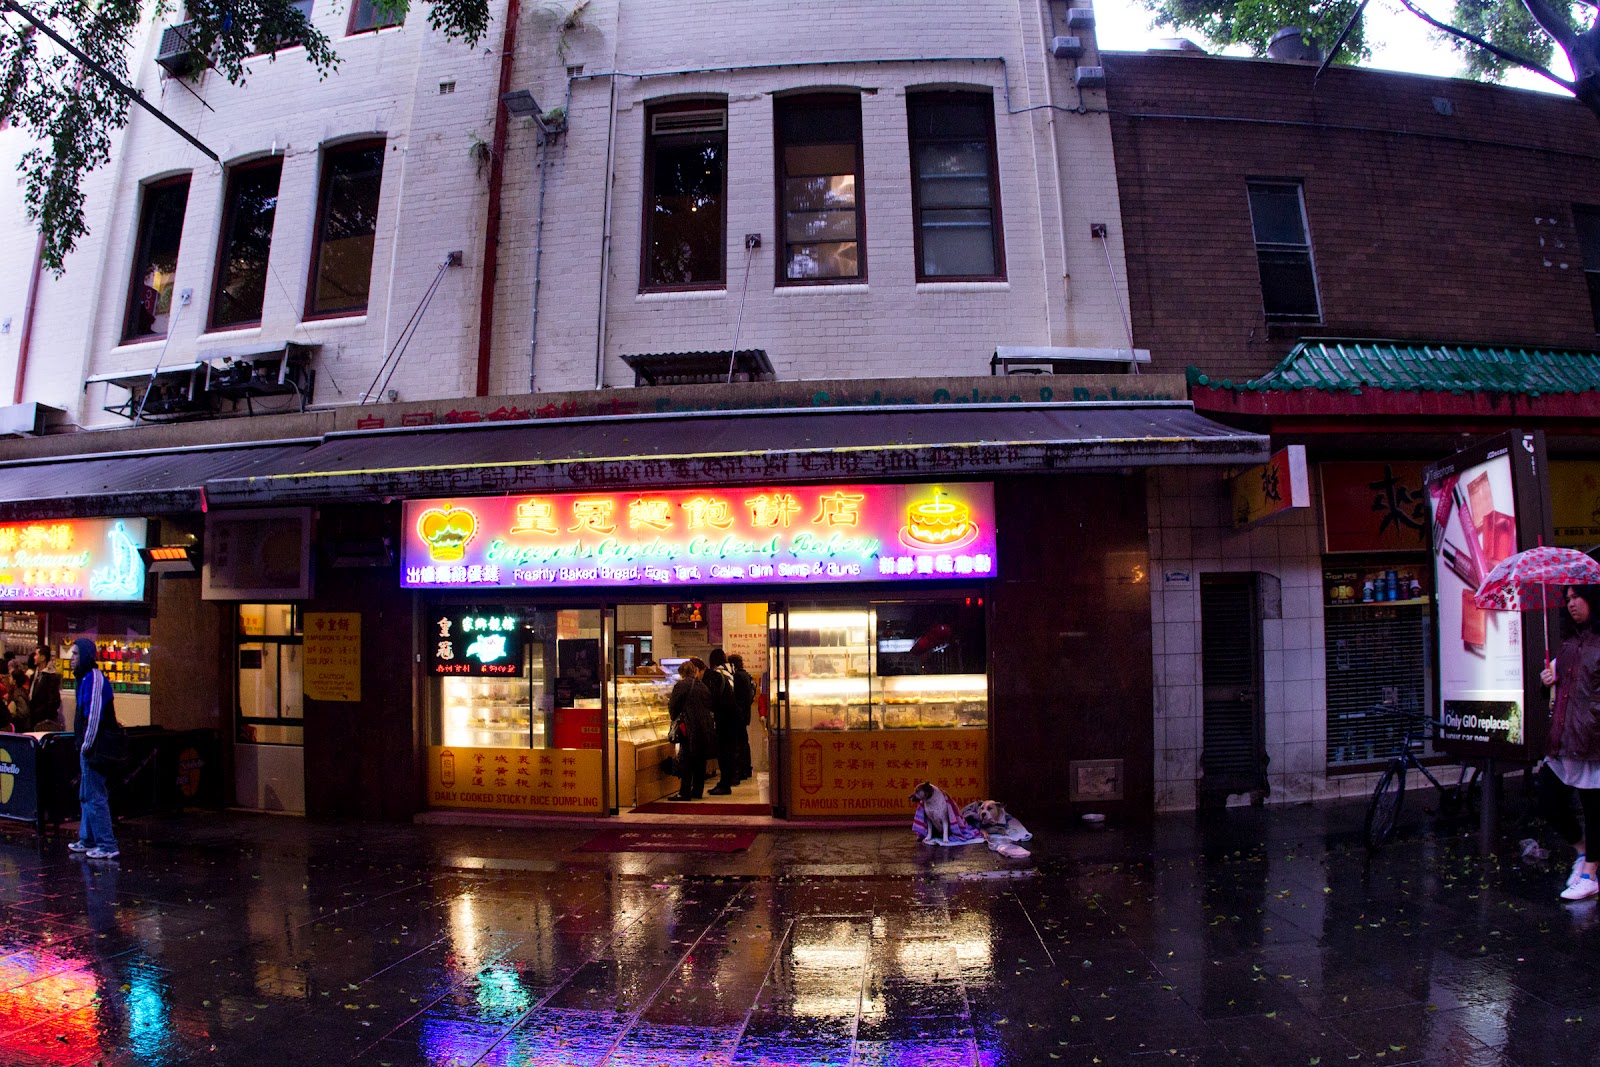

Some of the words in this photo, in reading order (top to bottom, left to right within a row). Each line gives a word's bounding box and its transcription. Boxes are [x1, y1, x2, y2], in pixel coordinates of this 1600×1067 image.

[596, 536, 680, 563] Garden
[788, 532, 880, 561] Bakery
[514, 567, 556, 583] Freshly
[560, 567, 598, 580] Baked
[601, 566, 641, 580] Bread,
[645, 566, 669, 583] Egg
[710, 565, 744, 579] Cake,
[748, 564, 773, 578] Dim
[778, 563, 809, 577] Sims
[813, 562, 823, 575] &
[827, 562, 861, 575] Buns
[33, 587, 81, 597] SPECIALTY
[1446, 714, 1462, 731] Only
[1463, 715, 1477, 728] GIO
[1478, 715, 1510, 732] replaces
[435, 791, 457, 802] DAILY
[460, 793, 494, 803] COOKED
[496, 794, 527, 805] STICKY
[531, 795, 550, 806] RICE
[553, 796, 599, 807] DUMPLING
[800, 798, 839, 809] FAMOUS
[843, 798, 905, 809] TRADITIONAL
